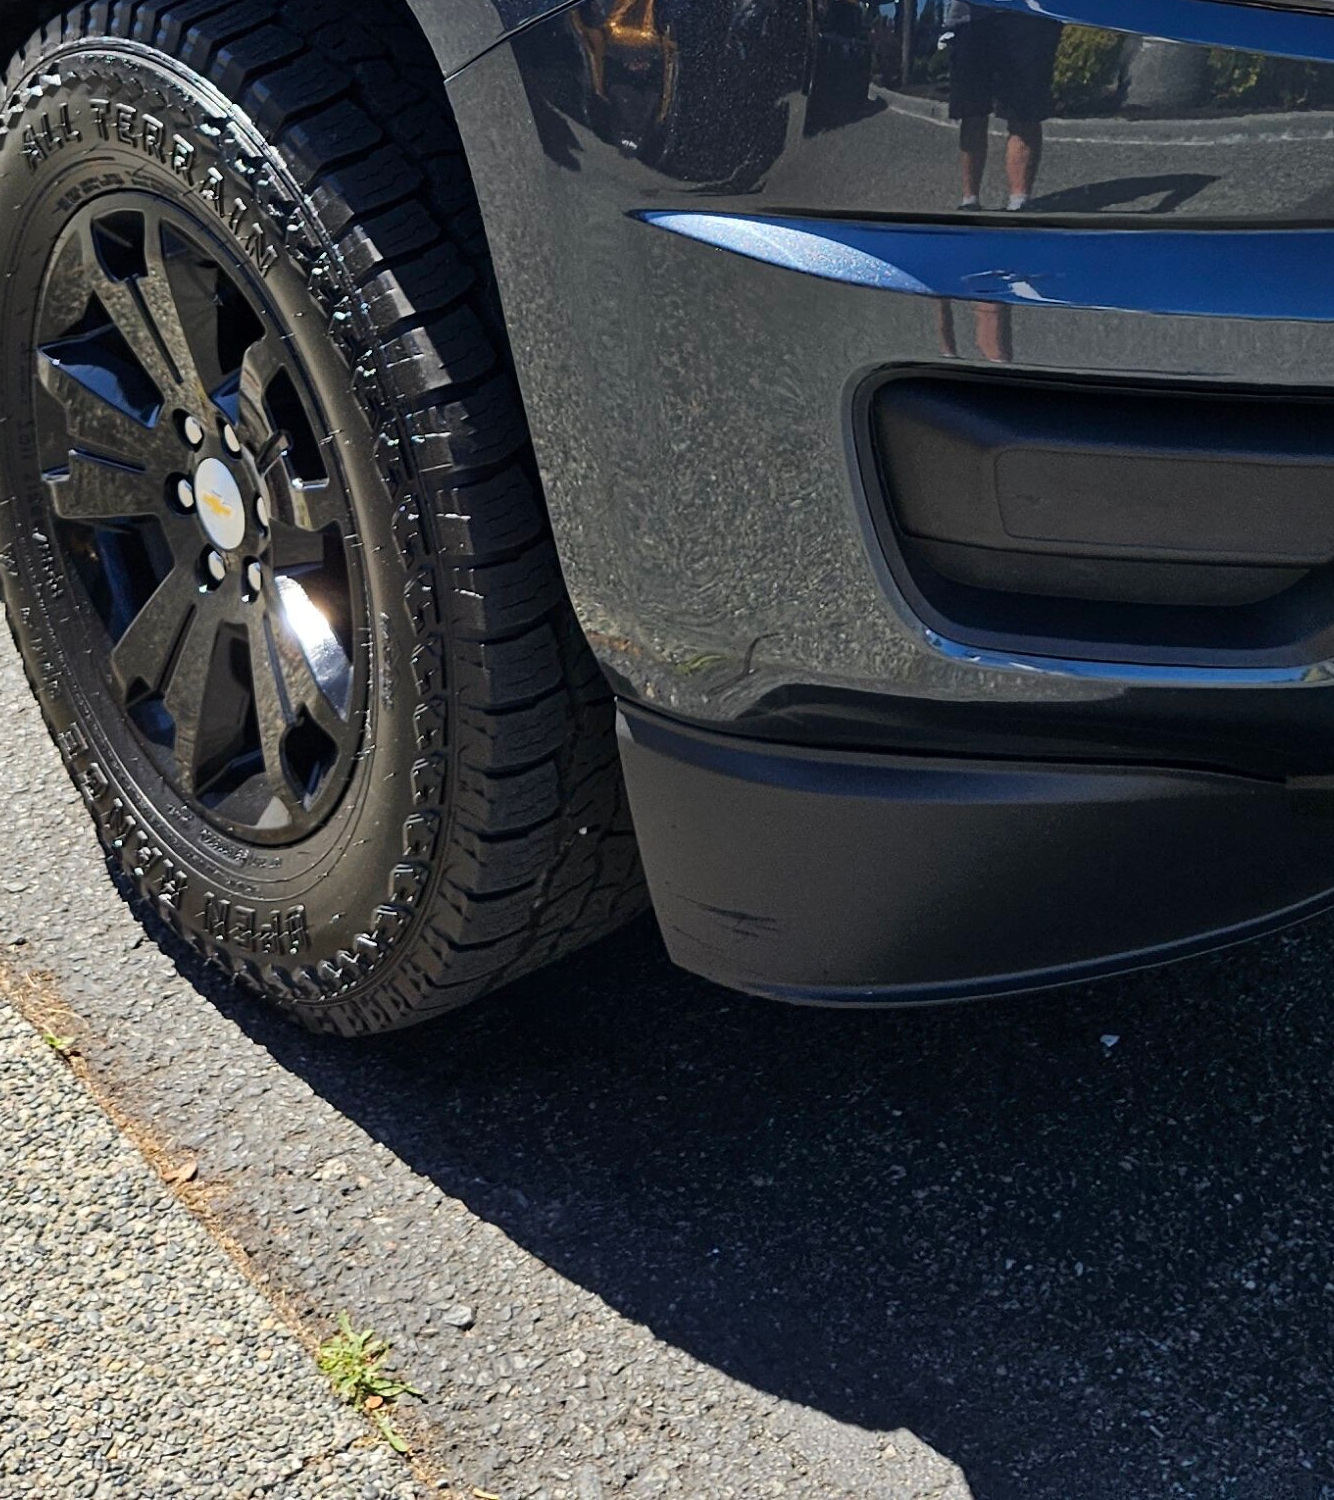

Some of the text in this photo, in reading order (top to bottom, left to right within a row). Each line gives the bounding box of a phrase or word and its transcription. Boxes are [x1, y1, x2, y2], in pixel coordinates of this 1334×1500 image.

[22, 98, 279, 279] ALL TERRAIN
[198, 890, 309, 956] OPEN
